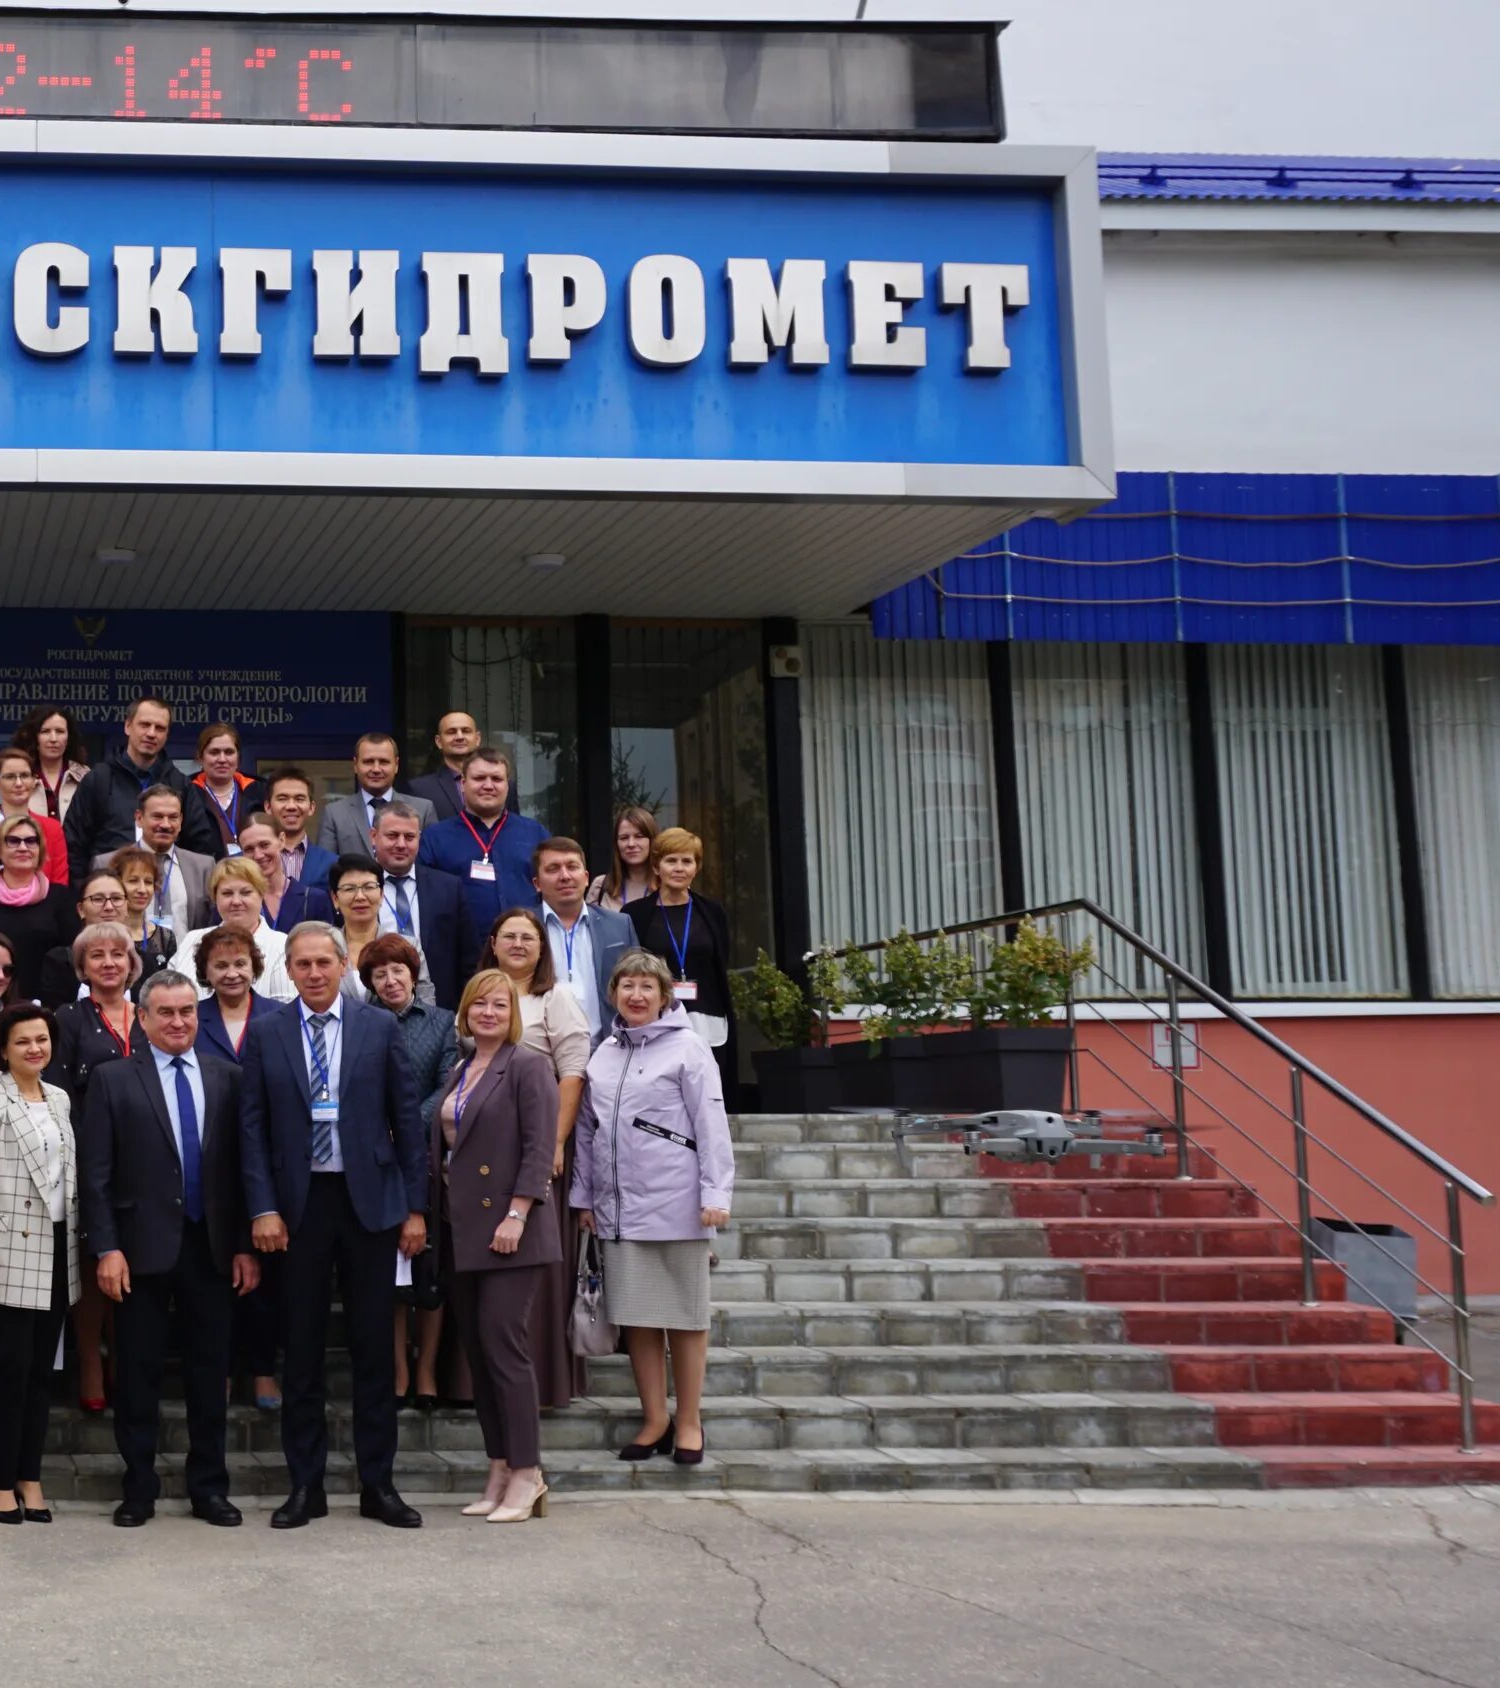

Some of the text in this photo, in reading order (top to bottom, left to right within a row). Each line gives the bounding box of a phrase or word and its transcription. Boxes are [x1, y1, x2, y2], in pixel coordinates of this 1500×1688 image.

[47, 649, 135, 662] РОСГИДРОМЕТ
[115, 668, 194, 683] БЮДЖЕТНОЕ
[198, 669, 282, 683] УЧРЕЖДЕНИЕ
[117, 684, 143, 701] ПО
[151, 685, 367, 704] ГИДРОМЕТЕОРОЛОГИИ
[218, 707, 293, 726] СРЕДЫ»
